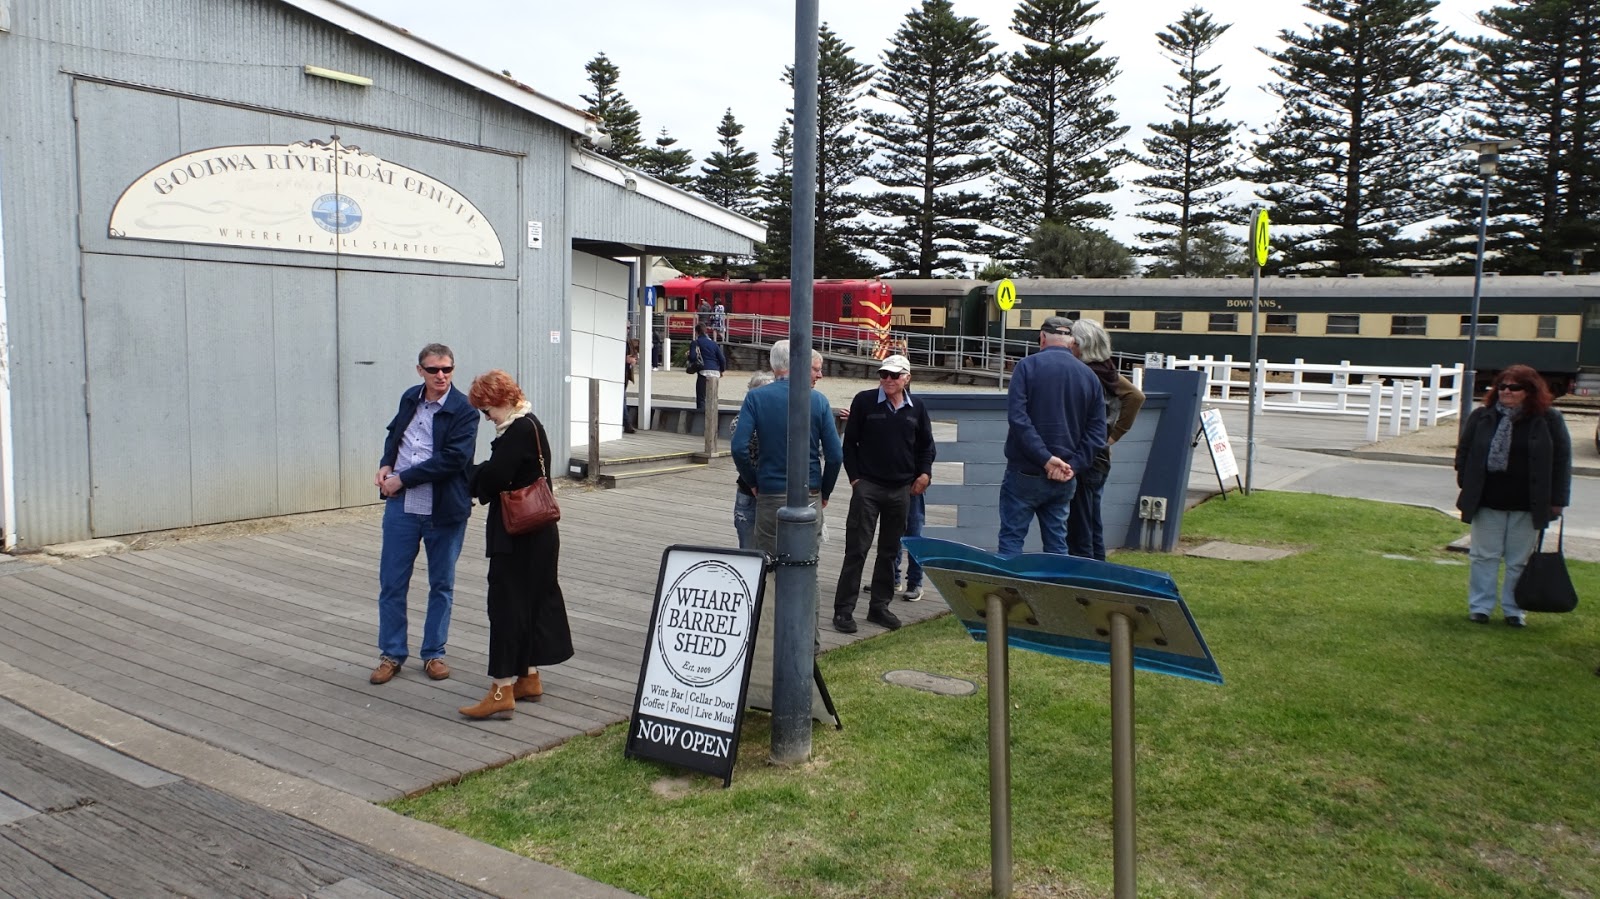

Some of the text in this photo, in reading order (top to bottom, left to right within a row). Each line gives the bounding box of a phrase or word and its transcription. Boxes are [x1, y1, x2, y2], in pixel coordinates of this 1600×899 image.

[153, 154, 256, 195] GOOLWA
[219, 227, 439, 254] WHERE IT ALL STARTED
[676, 587, 744, 612] WHARF
[667, 608, 741, 637] BARREL
[674, 632, 727, 658] SHED
[682, 661, 695, 672] Est.
[642, 697, 665, 710] Coffee
[670, 702, 690, 715] Food
[695, 707, 713, 720] Live
[650, 684, 735, 710] Wine Bar Cellar Door
[636, 719, 732, 758] NOW OPEN
